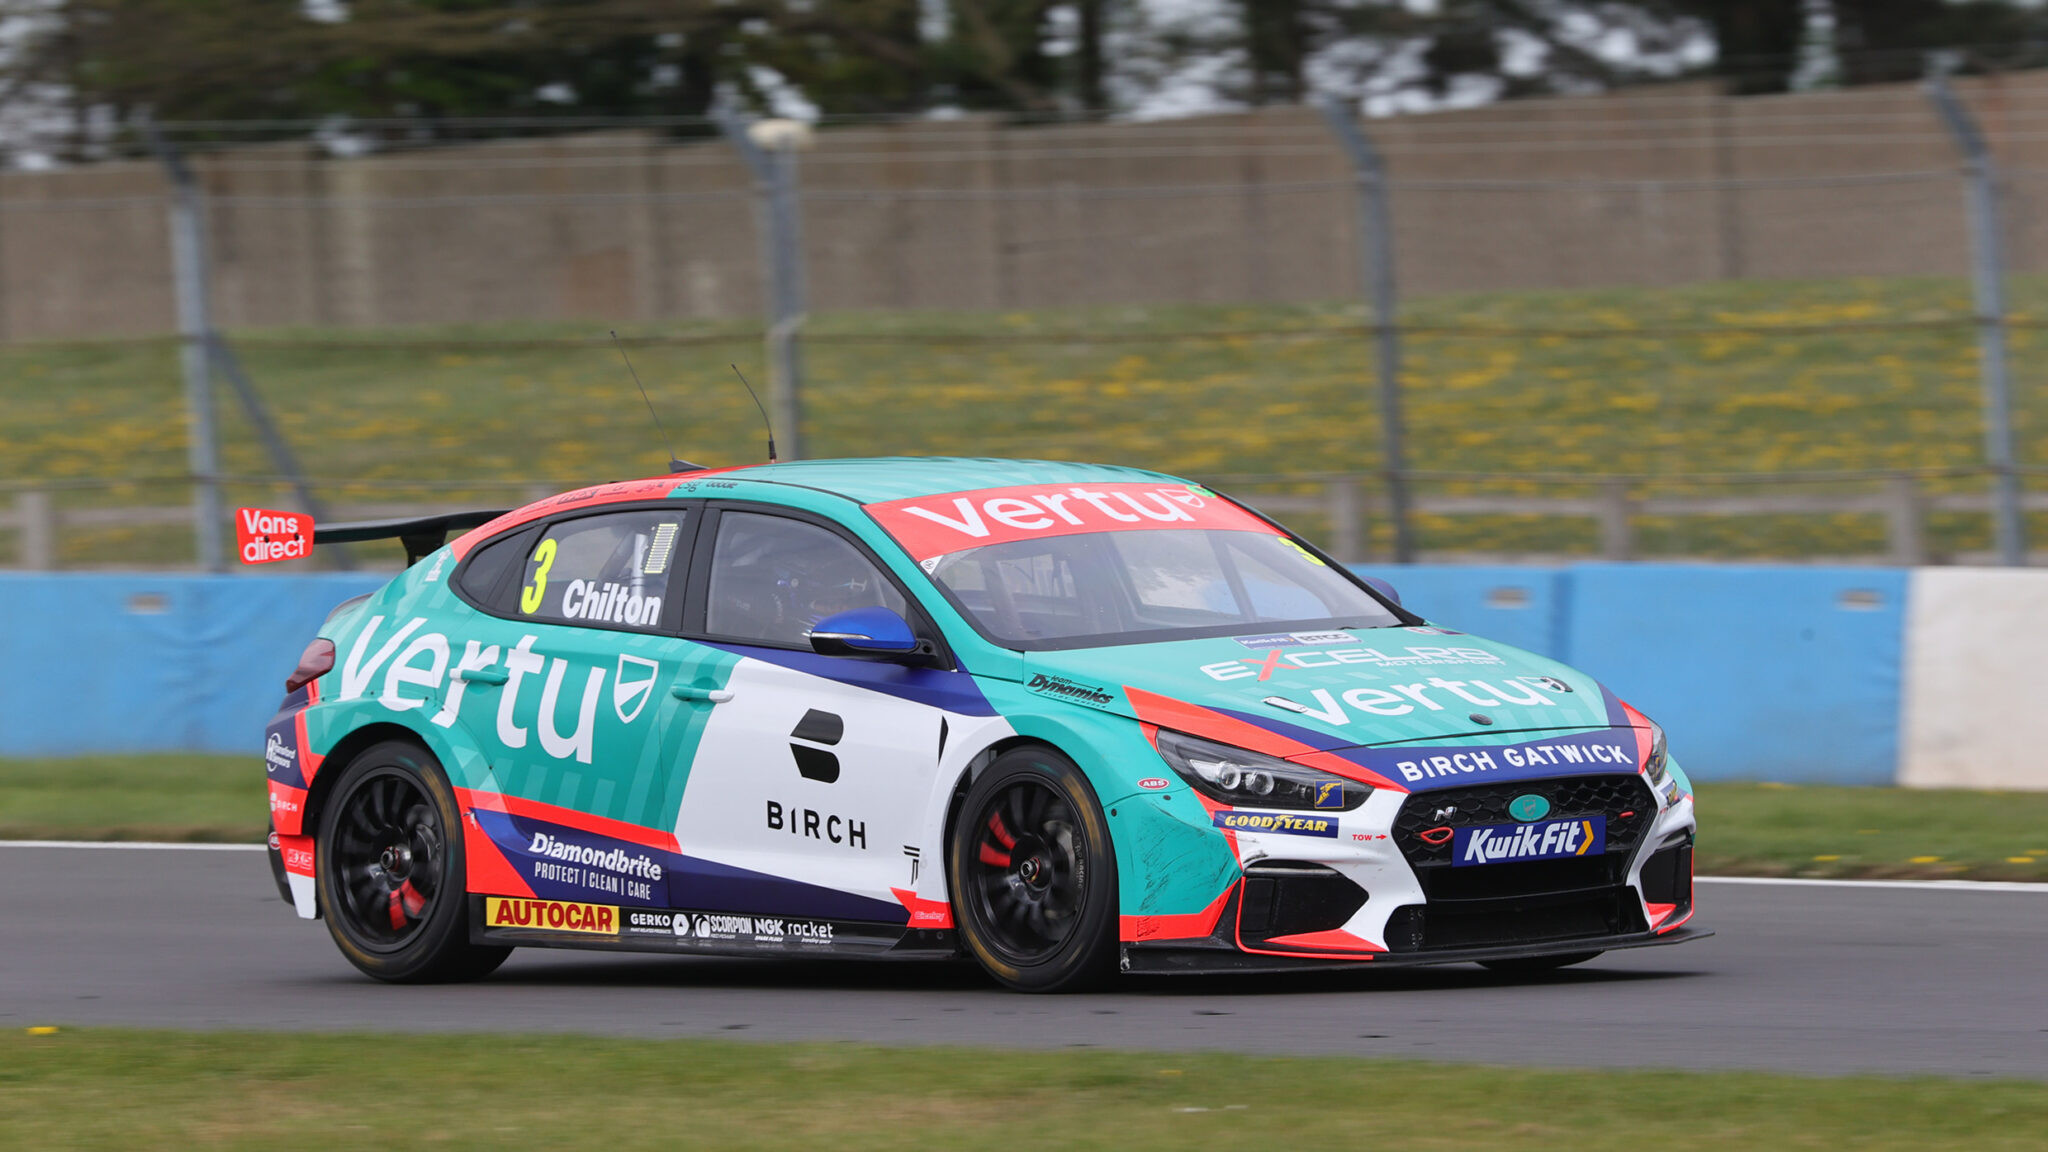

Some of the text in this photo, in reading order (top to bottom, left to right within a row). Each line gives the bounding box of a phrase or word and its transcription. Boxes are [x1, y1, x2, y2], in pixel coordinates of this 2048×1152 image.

[242, 509, 299, 534] Vans
[243, 535, 306, 562] direct
[521, 538, 558, 615] 3
[562, 579, 662, 627] Chilton
[1027, 674, 1115, 704] Dynamics
[1397, 744, 1634, 782] BIRCH GATWICK
[1142, 778, 1166, 788] ABS
[767, 800, 867, 850] BIRCH
[528, 832, 662, 881] Diamondbrite
[534, 861, 651, 900] PROTECT CLEAN CARE
[495, 900, 613, 932] AUTOCAR
[630, 913, 671, 927] GERKO
[711, 915, 753, 934] SCORPION
[754, 918, 785, 936] NGK
[787, 921, 834, 938] rocket
